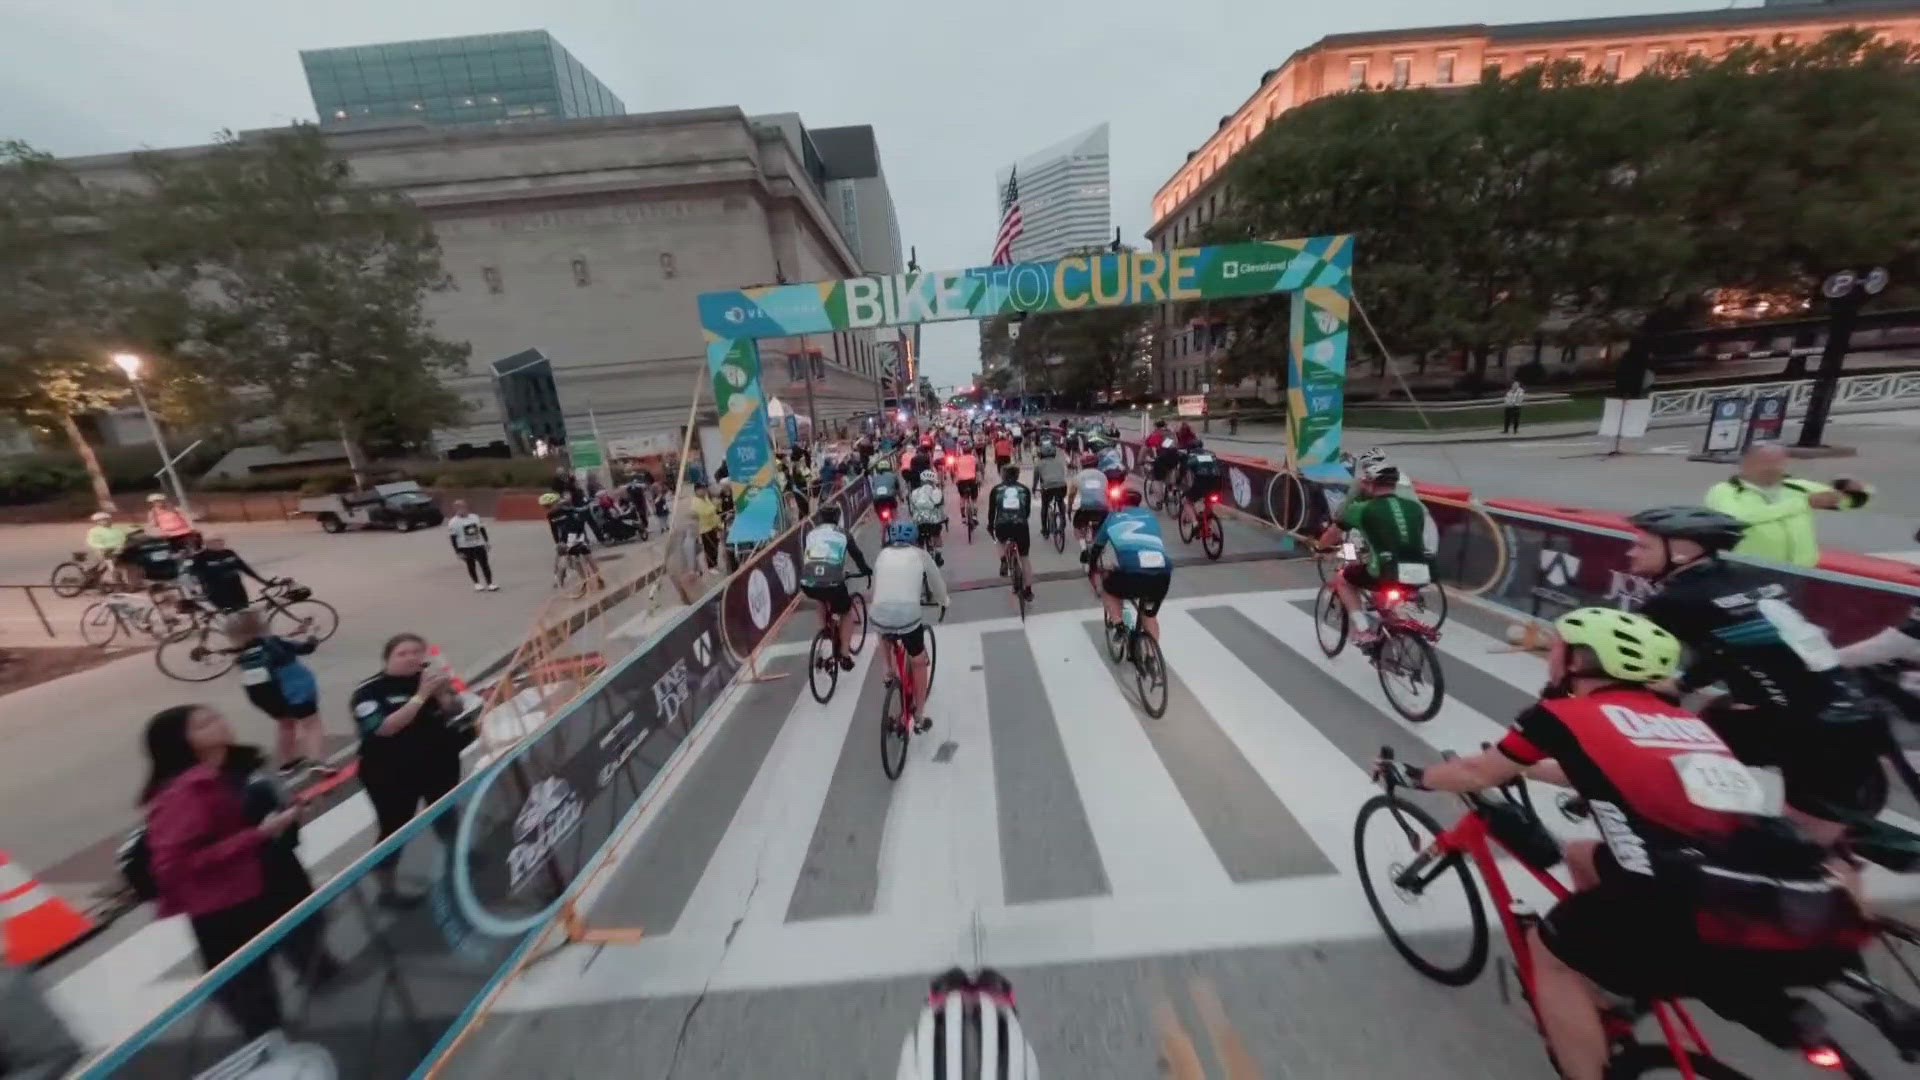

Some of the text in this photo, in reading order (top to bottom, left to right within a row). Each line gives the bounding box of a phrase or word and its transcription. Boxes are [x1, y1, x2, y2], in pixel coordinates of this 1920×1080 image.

[844, 249, 1200, 329] BIKE TO CURE
